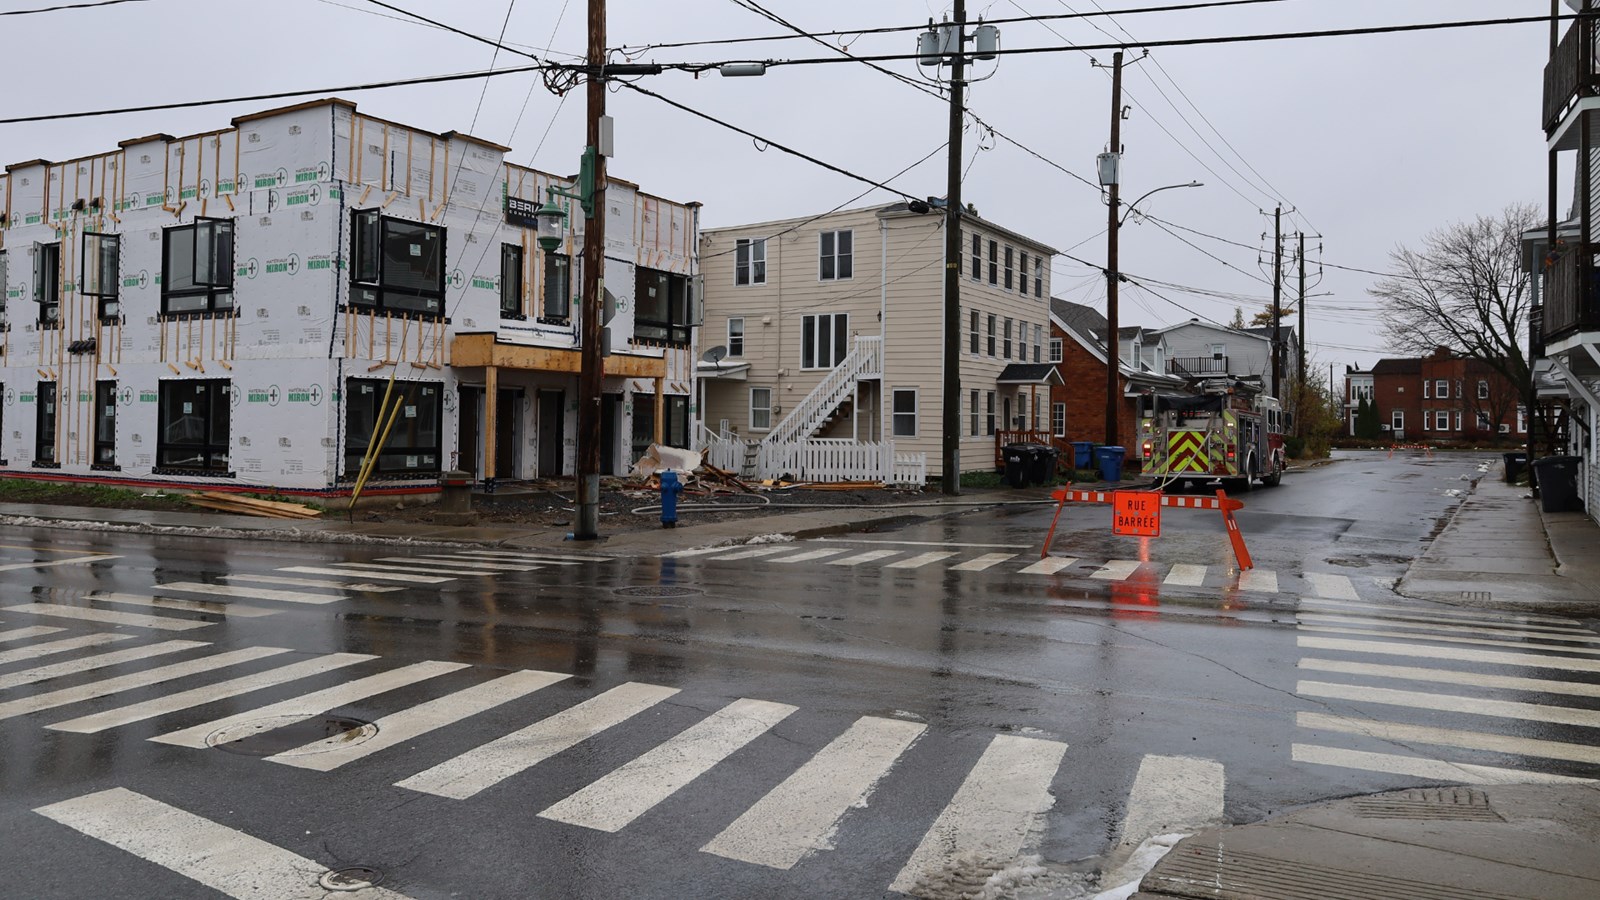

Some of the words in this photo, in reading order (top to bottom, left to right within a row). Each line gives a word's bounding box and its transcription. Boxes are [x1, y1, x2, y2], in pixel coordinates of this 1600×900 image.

[254, 177, 276, 188] MIRON
[295, 171, 318, 183] MIRON
[286, 193, 309, 205] MIRON
[265, 263, 288, 273] MIRON
[307, 260, 331, 270] MIRON
[472, 279, 494, 290] MIRON
[247, 394, 269, 402] MIRON
[287, 393, 310, 402] MIRON
[1127, 500, 1146, 511] RUE
[1118, 515, 1155, 528] BARRÉE
